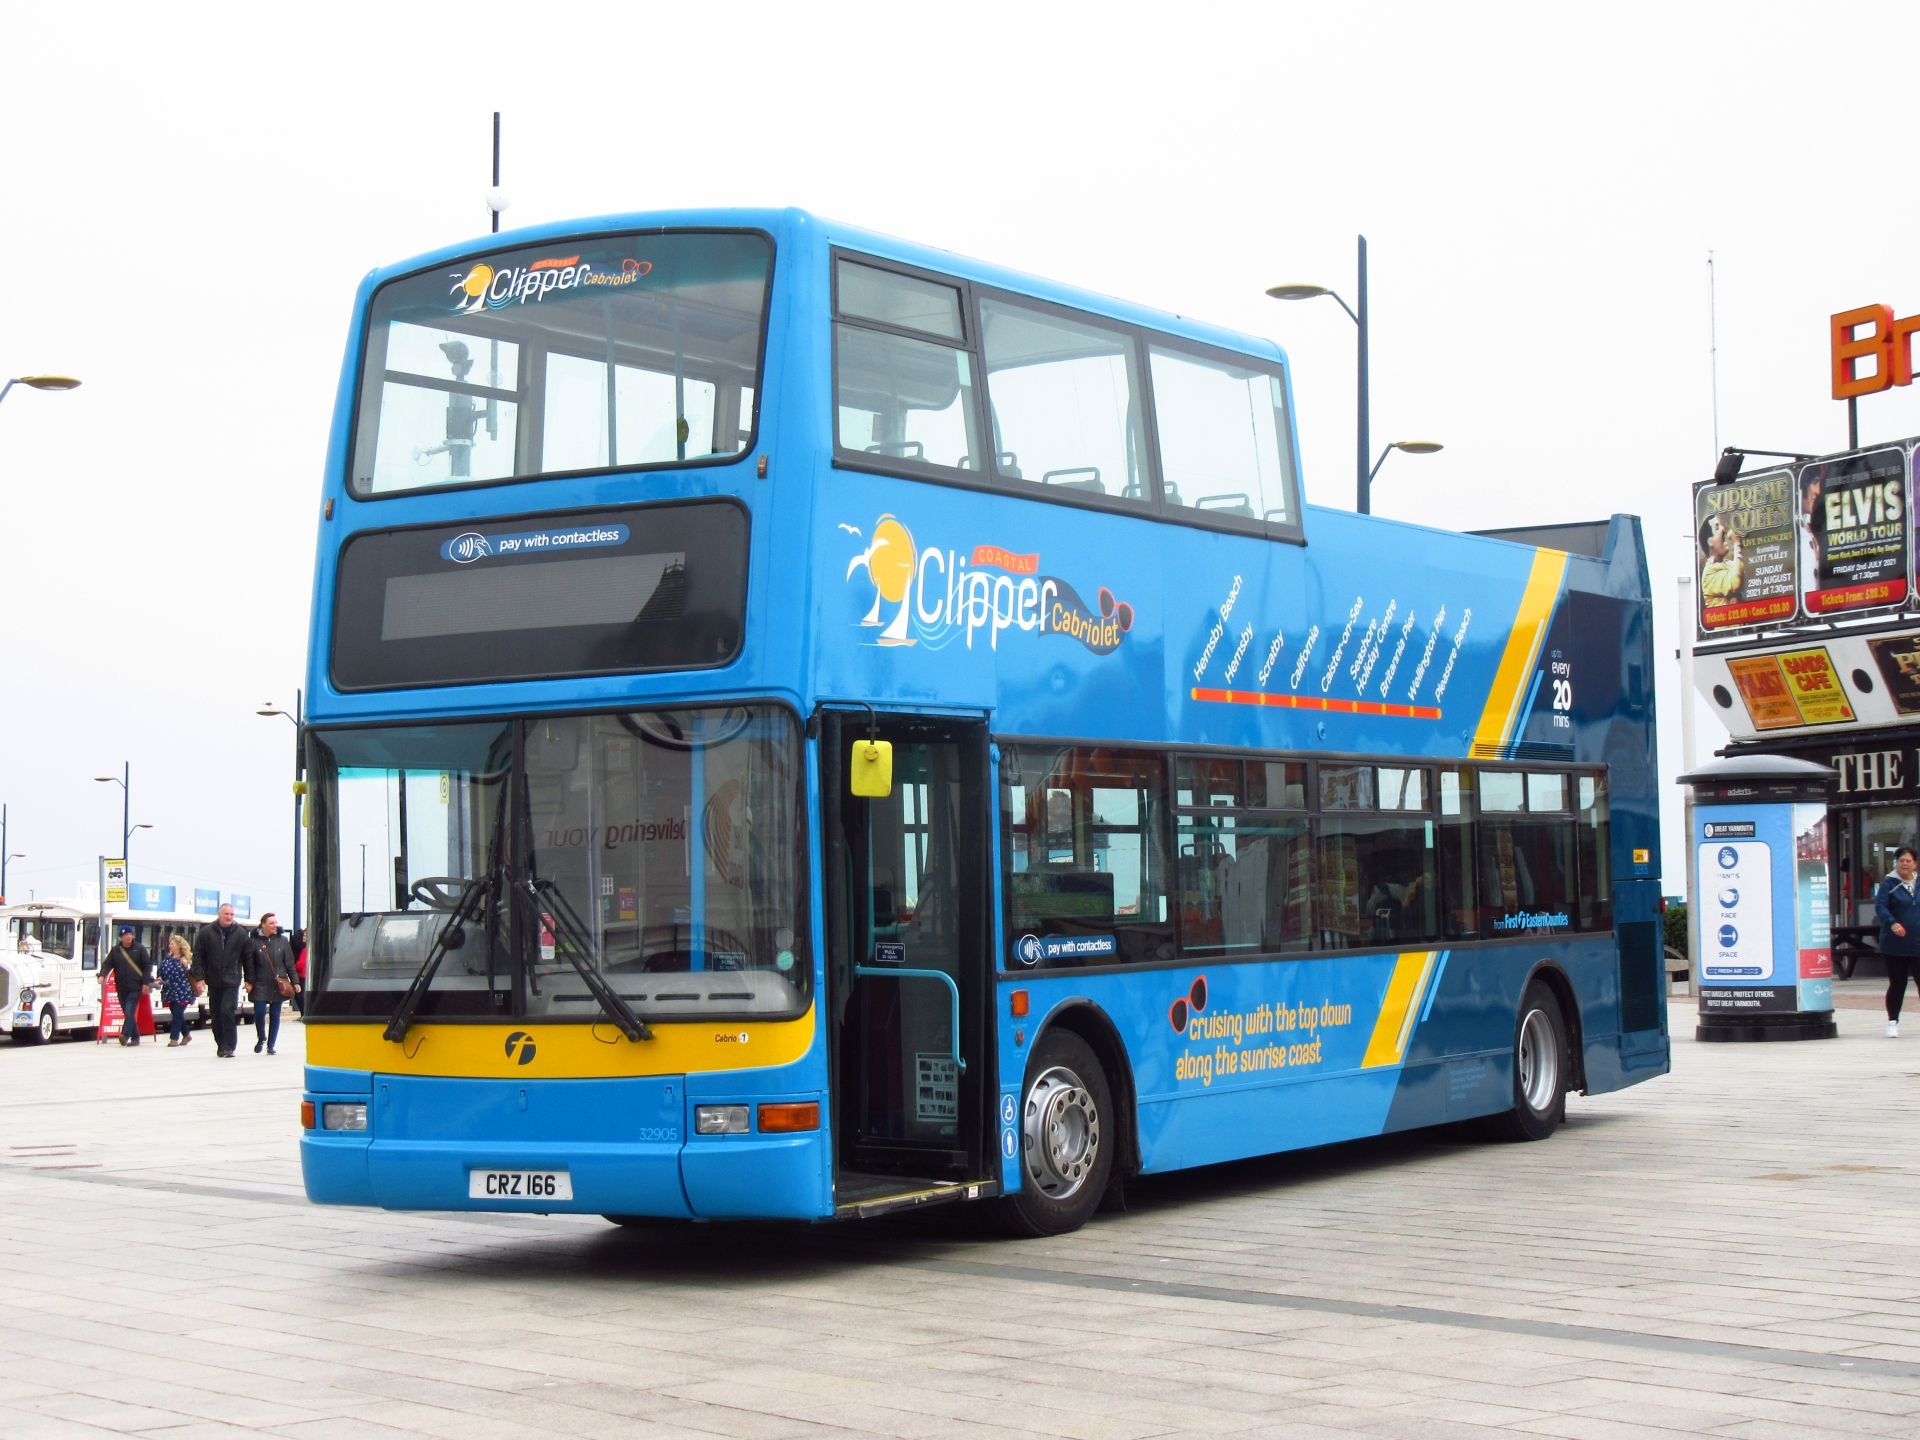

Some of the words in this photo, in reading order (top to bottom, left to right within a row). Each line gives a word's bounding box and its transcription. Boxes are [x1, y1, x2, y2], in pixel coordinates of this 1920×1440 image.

[536, 259, 573, 269] COASTAL
[490, 264, 591, 305] Clipper
[583, 270, 637, 286] Cabriolet
[1706, 477, 1789, 515] SUPREME
[1825, 481, 1904, 530] ELVIS
[1730, 502, 1790, 537] QUEEN
[500, 539, 520, 552] pay
[524, 534, 550, 548] with
[552, 529, 619, 545] contactless
[1743, 539, 1756, 547] LIVE
[1764, 532, 1793, 543] CONCERT
[1828, 528, 1868, 546] WORLD
[1871, 523, 1903, 539] TOUR
[978, 549, 1032, 571] COASTAL
[1748, 554, 1767, 564] SCOTT
[1755, 564, 1783, 576] SUNDAY
[1833, 565, 1855, 574] FRIDAY
[1856, 562, 1866, 571] 2nd
[1868, 560, 1882, 569] JULY
[1883, 557, 1896, 567] 2021
[1748, 579, 1761, 588] 29th
[1763, 573, 1792, 585] AUGUST
[1859, 570, 1879, 579] 7.30pm
[916, 546, 1058, 651] Clipper
[1052, 602, 1120, 646] Cabriolet
[1746, 589, 1761, 598] 2021
[1762, 587, 1769, 595] at
[1770, 584, 1794, 594] 7.30pm
[1821, 593, 1844, 606] Tickets
[1194, 618, 1224, 682] Hemsby
[1220, 574, 1243, 622] Beach
[1706, 612, 1727, 623] Tickets:
[1225, 621, 1253, 684] Hemsby
[1321, 596, 1363, 693] Caister-on-Sea
[1350, 618, 1377, 680] Seashore
[1356, 642, 1379, 696] Holiday
[1377, 599, 1397, 643] Centre
[1380, 638, 1405, 698] Britannia
[1402, 610, 1415, 640] Pier
[1408, 631, 1437, 701] Wellington
[1434, 604, 1446, 633] Pier
[1435, 648, 1457, 703] Pleasure
[1454, 608, 1472, 649] Beach
[1258, 629, 1284, 686] Scratby
[1290, 625, 1320, 689] California
[1783, 654, 1829, 675] SANDS
[1552, 661, 1570, 678] every
[1796, 672, 1833, 692] CAFE
[1553, 679, 1572, 711] 20
[1554, 711, 1570, 728] mins
[1832, 750, 1904, 792] THE
[1728, 824, 1754, 832] YARMOUTH
[1494, 919, 1505, 929] from
[1505, 913, 1518, 929] First
[1048, 944, 1060, 956] pay
[1061, 940, 1075, 952] with
[1076, 939, 1112, 952] contactless
[1189, 1009, 1243, 1045] cruising
[1245, 1003, 1273, 1035] with
[1276, 1002, 1296, 1031] the
[1298, 1000, 1318, 1037] top
[1321, 998, 1351, 1027] down
[715, 1034, 737, 1043] Cabrio
[1175, 1048, 1212, 1086] along
[1215, 1044, 1238, 1075] the
[1240, 1042, 1286, 1072] sunrise
[1288, 1034, 1322, 1066] coast
[639, 1127, 677, 1141] 32905
[486, 1173, 522, 1195] CRZ
[527, 1174, 556, 1196] 166
